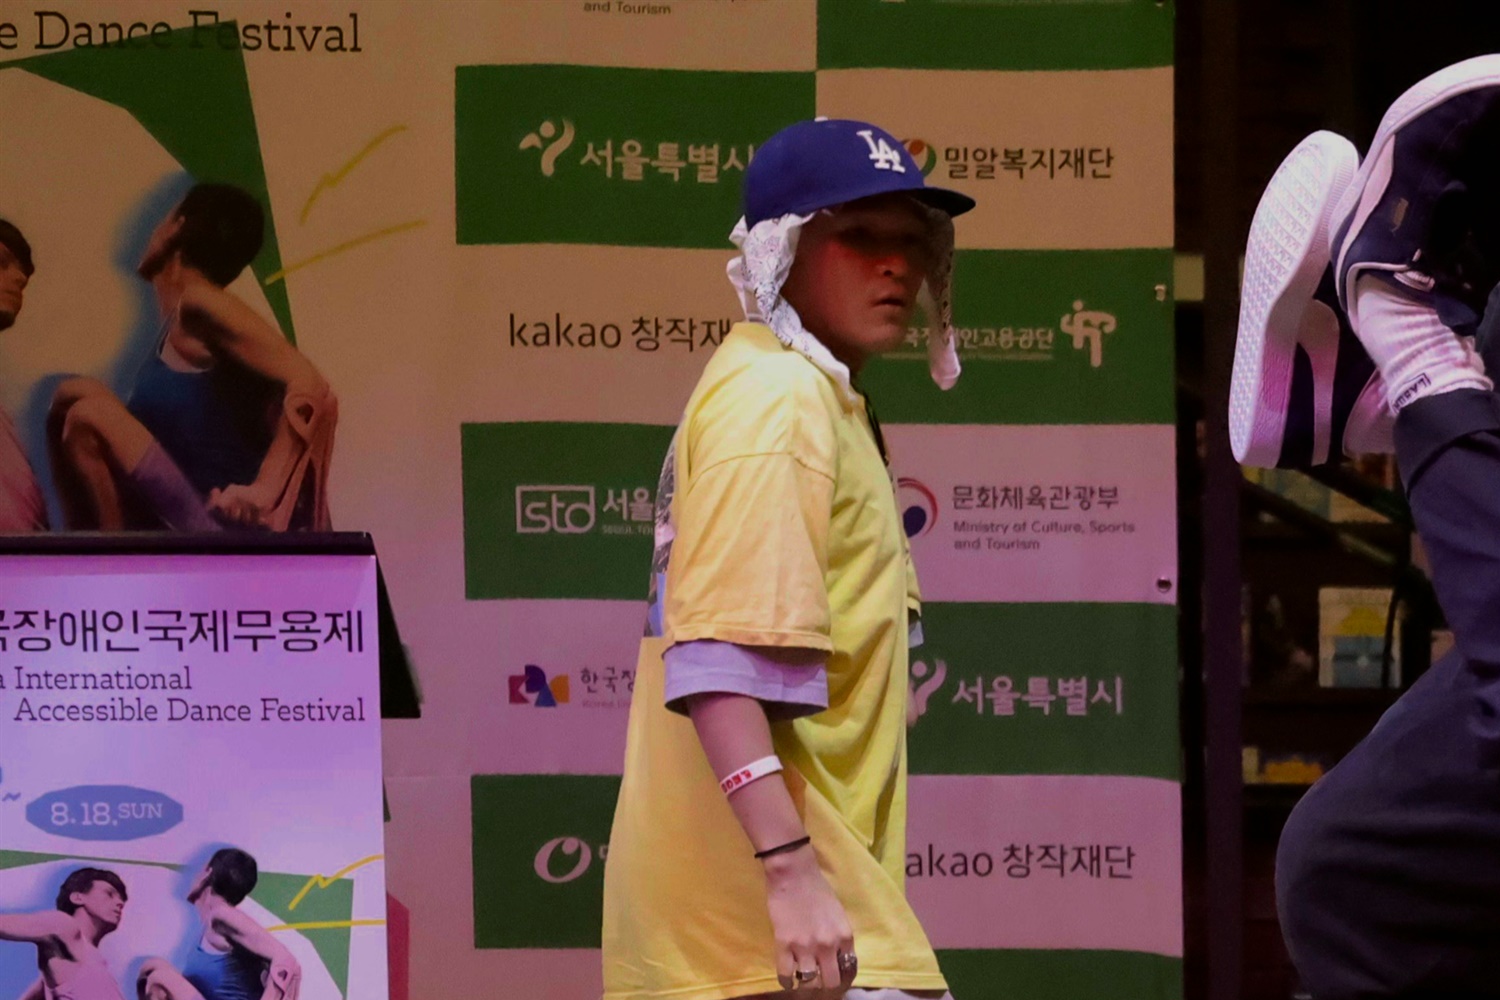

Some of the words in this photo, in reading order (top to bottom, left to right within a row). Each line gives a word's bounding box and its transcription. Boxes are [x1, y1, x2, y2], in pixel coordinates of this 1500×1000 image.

[616, 1, 672, 15] Tourism
[34, 11, 173, 50] Dance
[188, 10, 363, 53] Festival
[856, 129, 906, 174] LA
[944, 147, 1114, 180] 밀알복지재단
[509, 312, 622, 349] kakao
[952, 485, 1120, 511] 문화체육관광부
[953, 520, 1009, 535] Ministry
[1012, 520, 1028, 533] of
[1031, 520, 1086, 535] Culture,
[1090, 520, 1136, 535] Sports
[953, 538, 981, 550] and
[986, 538, 1040, 550] Tourism
[0, 609, 364, 652] 장애인국제무용제
[14, 665, 193, 690] International
[14, 697, 158, 722] Accessible
[167, 698, 251, 722] Dance
[260, 697, 366, 722] Festival
[952, 675, 1123, 716] 서울특별시
[1003, 843, 1136, 879] 창작재단
